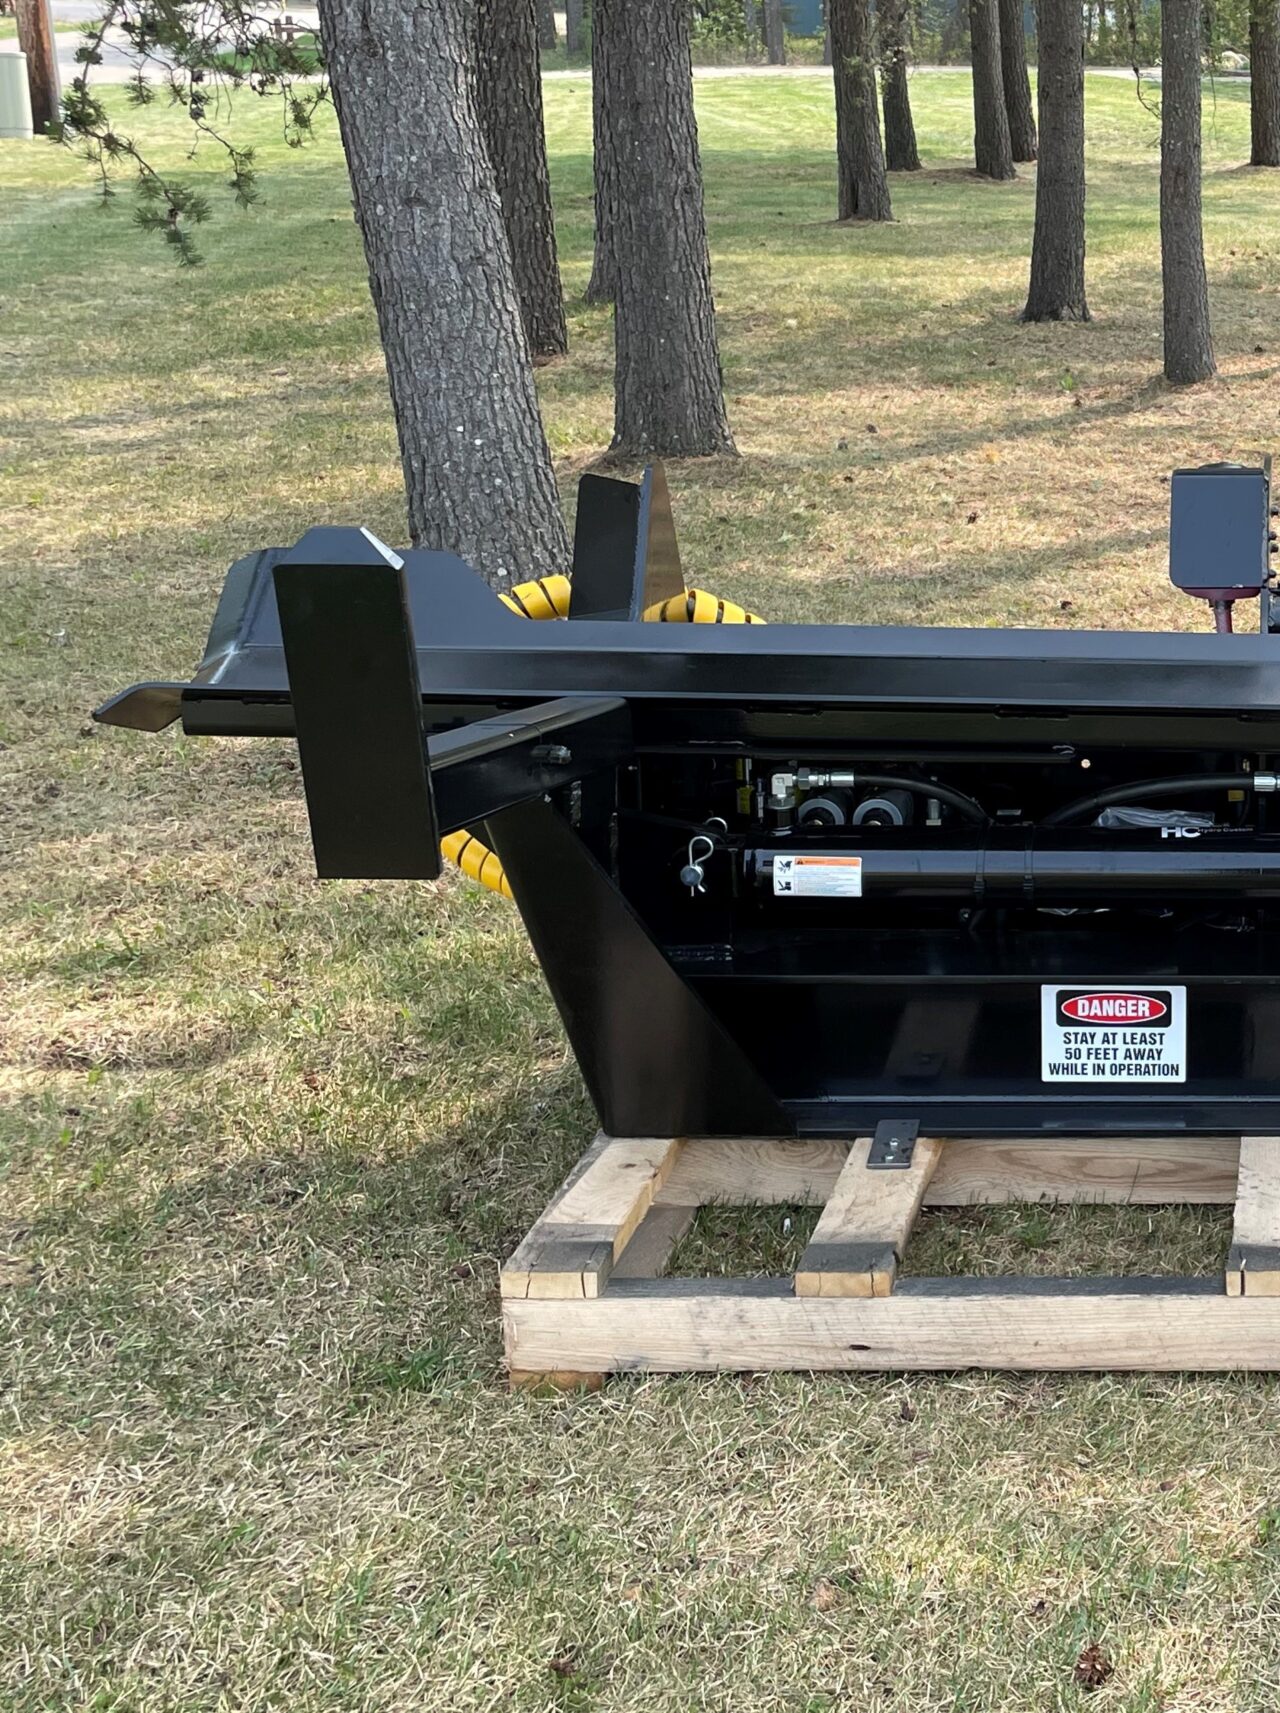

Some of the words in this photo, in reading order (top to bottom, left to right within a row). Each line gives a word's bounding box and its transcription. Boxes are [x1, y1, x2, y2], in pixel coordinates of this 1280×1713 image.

[1077, 999, 1150, 1017] DANGER
[1063, 1032, 1097, 1045] STAY
[1101, 1032, 1118, 1045] AT
[1123, 1032, 1166, 1045] LEAST
[1065, 1047, 1082, 1060] 50
[1087, 1047, 1119, 1060] FEET
[1124, 1048, 1164, 1060] AWAY
[1048, 1063, 1088, 1076] WHILE
[1092, 1063, 1105, 1076] IN
[1109, 1063, 1179, 1076] OPERATION
